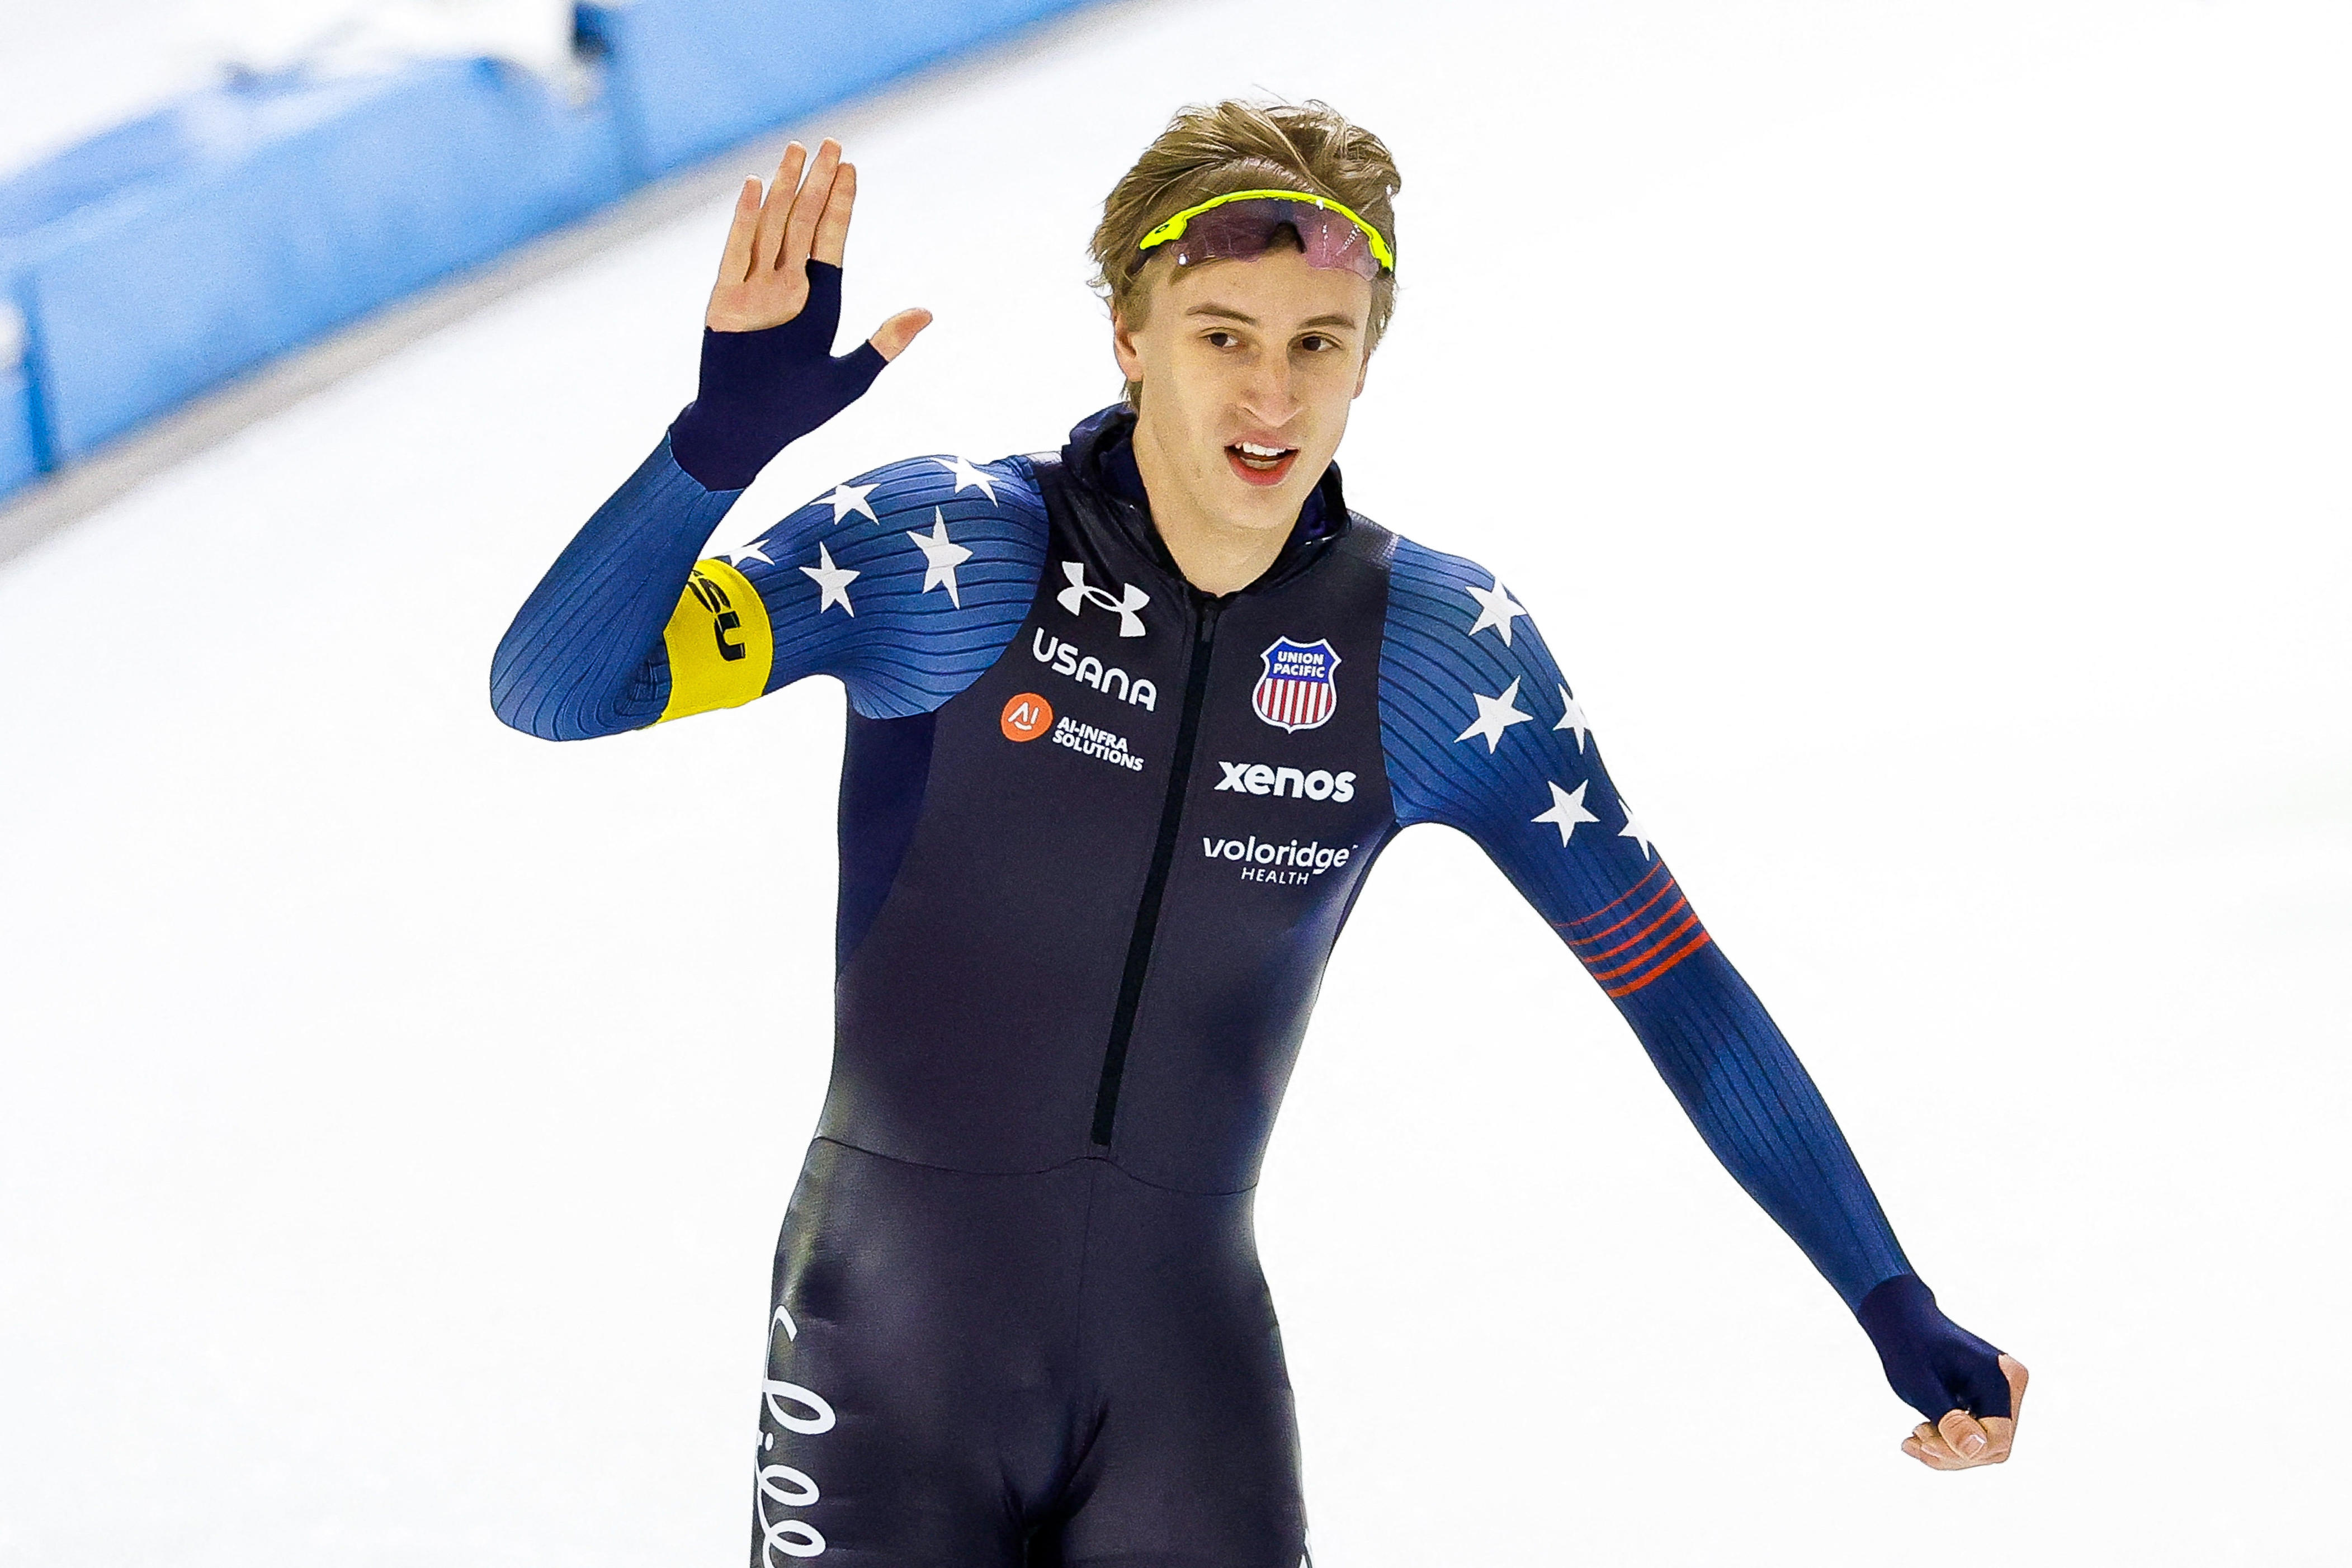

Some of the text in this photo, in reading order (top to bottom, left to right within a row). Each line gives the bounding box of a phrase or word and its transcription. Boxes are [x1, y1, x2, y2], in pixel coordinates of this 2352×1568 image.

[687, 569, 746, 662] SU
[1032, 627, 1157, 711] USANA
[1273, 663, 1325, 678] PACIFIC
[1277, 651, 1324, 665] UNION
[1008, 701, 1040, 725] AI
[1052, 729, 1144, 771] SOLUTIONS
[1057, 716, 1128, 753] AI-INFRA
[1213, 761, 1357, 803] xenos
[1203, 835, 1349, 875] voloridge
[1241, 867, 1310, 885] HEALTH
